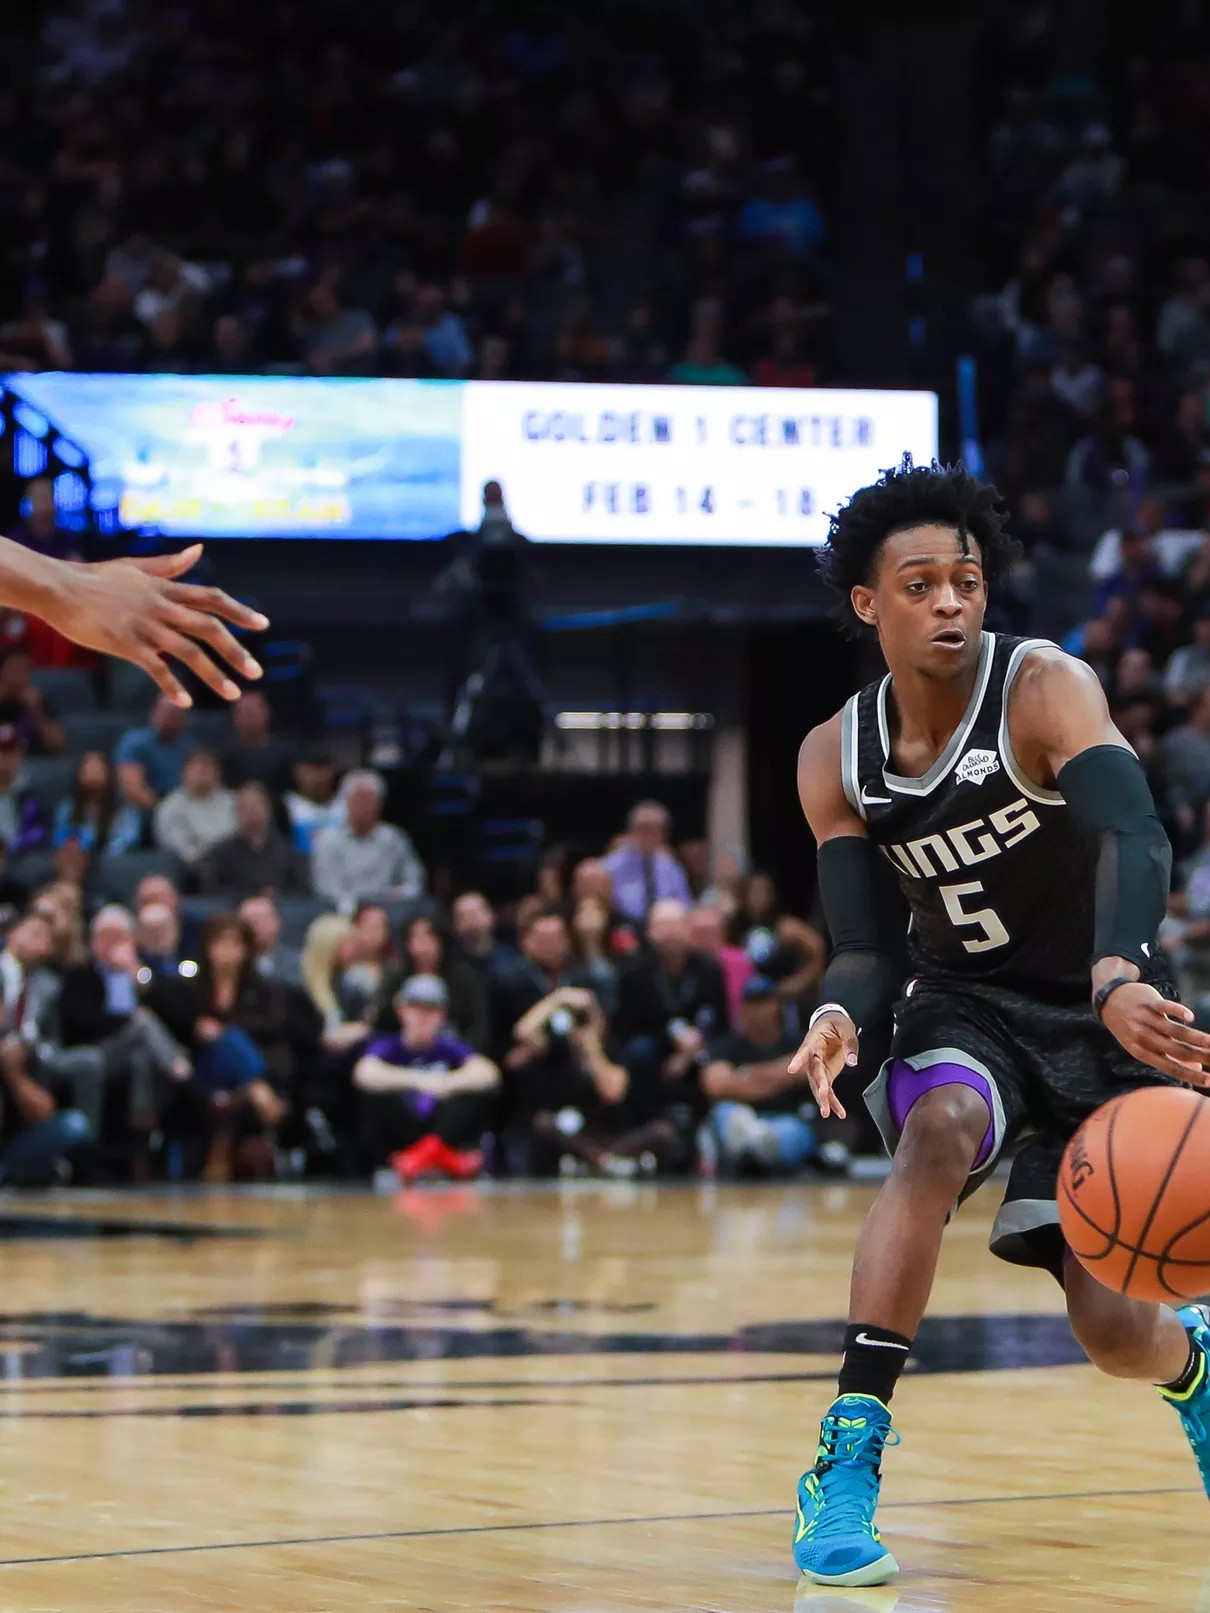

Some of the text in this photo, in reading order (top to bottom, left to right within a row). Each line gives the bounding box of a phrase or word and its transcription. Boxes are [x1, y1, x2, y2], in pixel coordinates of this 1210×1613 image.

[521, 409, 874, 448] GOLDEN 1 CENTER
[582, 480, 651, 516] FEB
[676, 486, 716, 516] 14
[879, 798, 1041, 879] INGS
[938, 880, 1010, 953] 5
